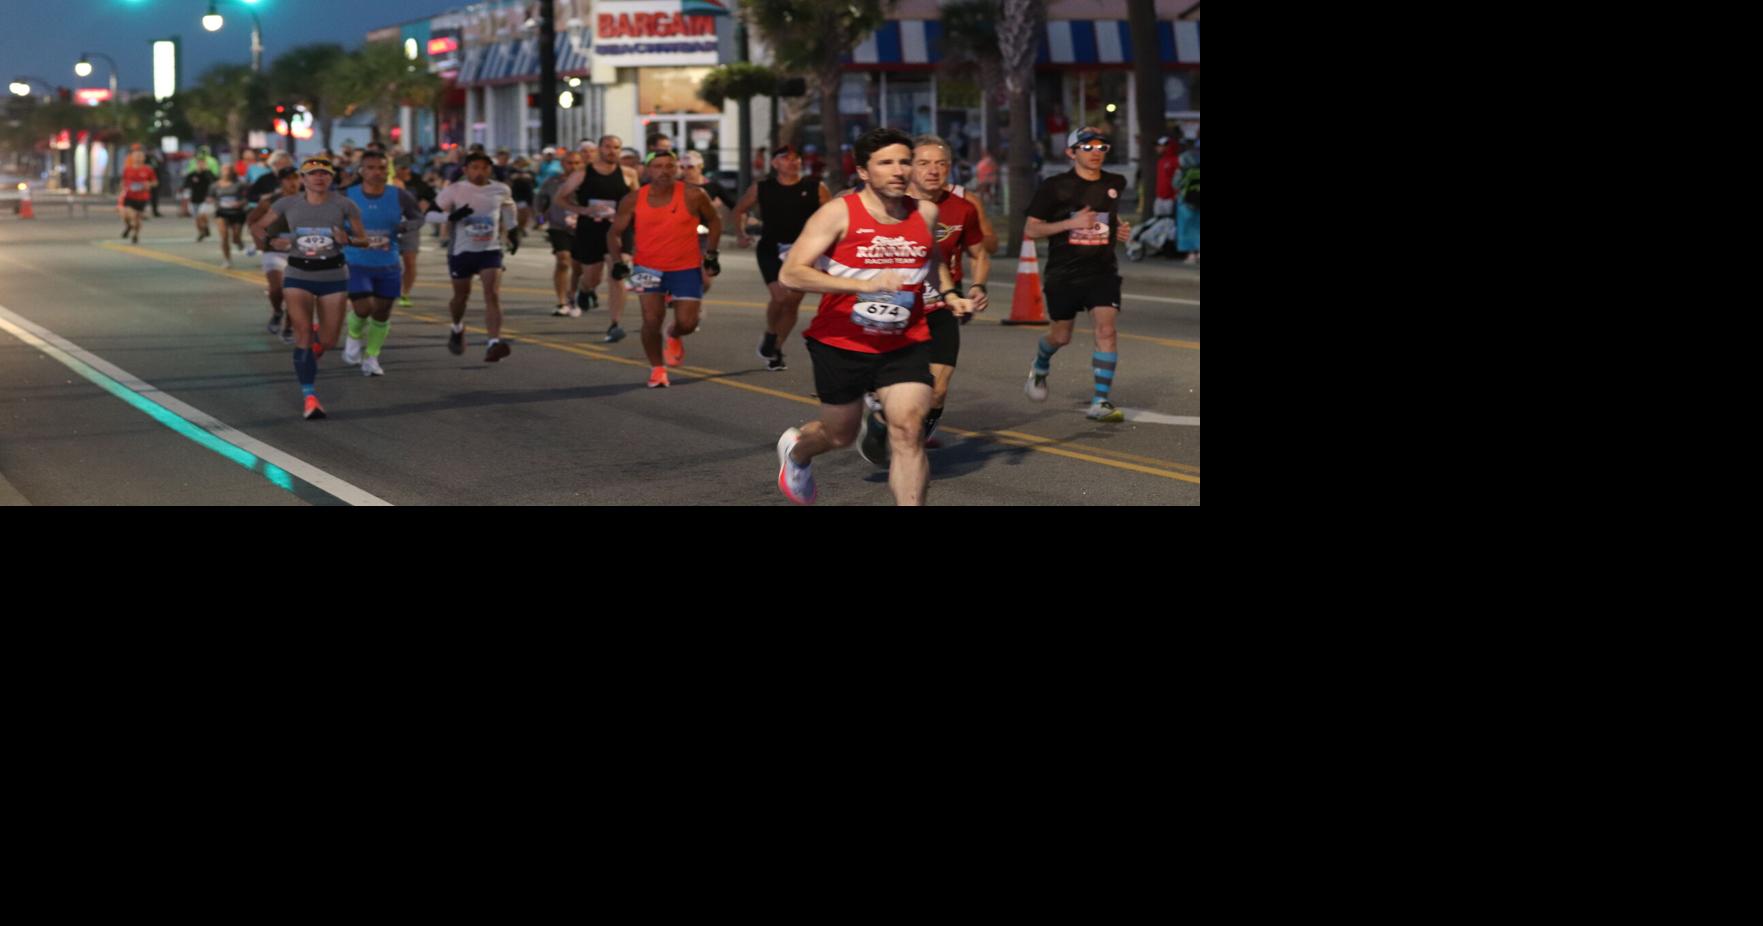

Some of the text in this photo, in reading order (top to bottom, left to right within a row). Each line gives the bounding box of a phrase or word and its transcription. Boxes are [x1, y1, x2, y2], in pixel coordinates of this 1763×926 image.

[597, 11, 716, 38] BARGAIN
[304, 236, 325, 244] 492
[856, 246, 928, 257] RUNNING
[866, 303, 900, 316] 674
